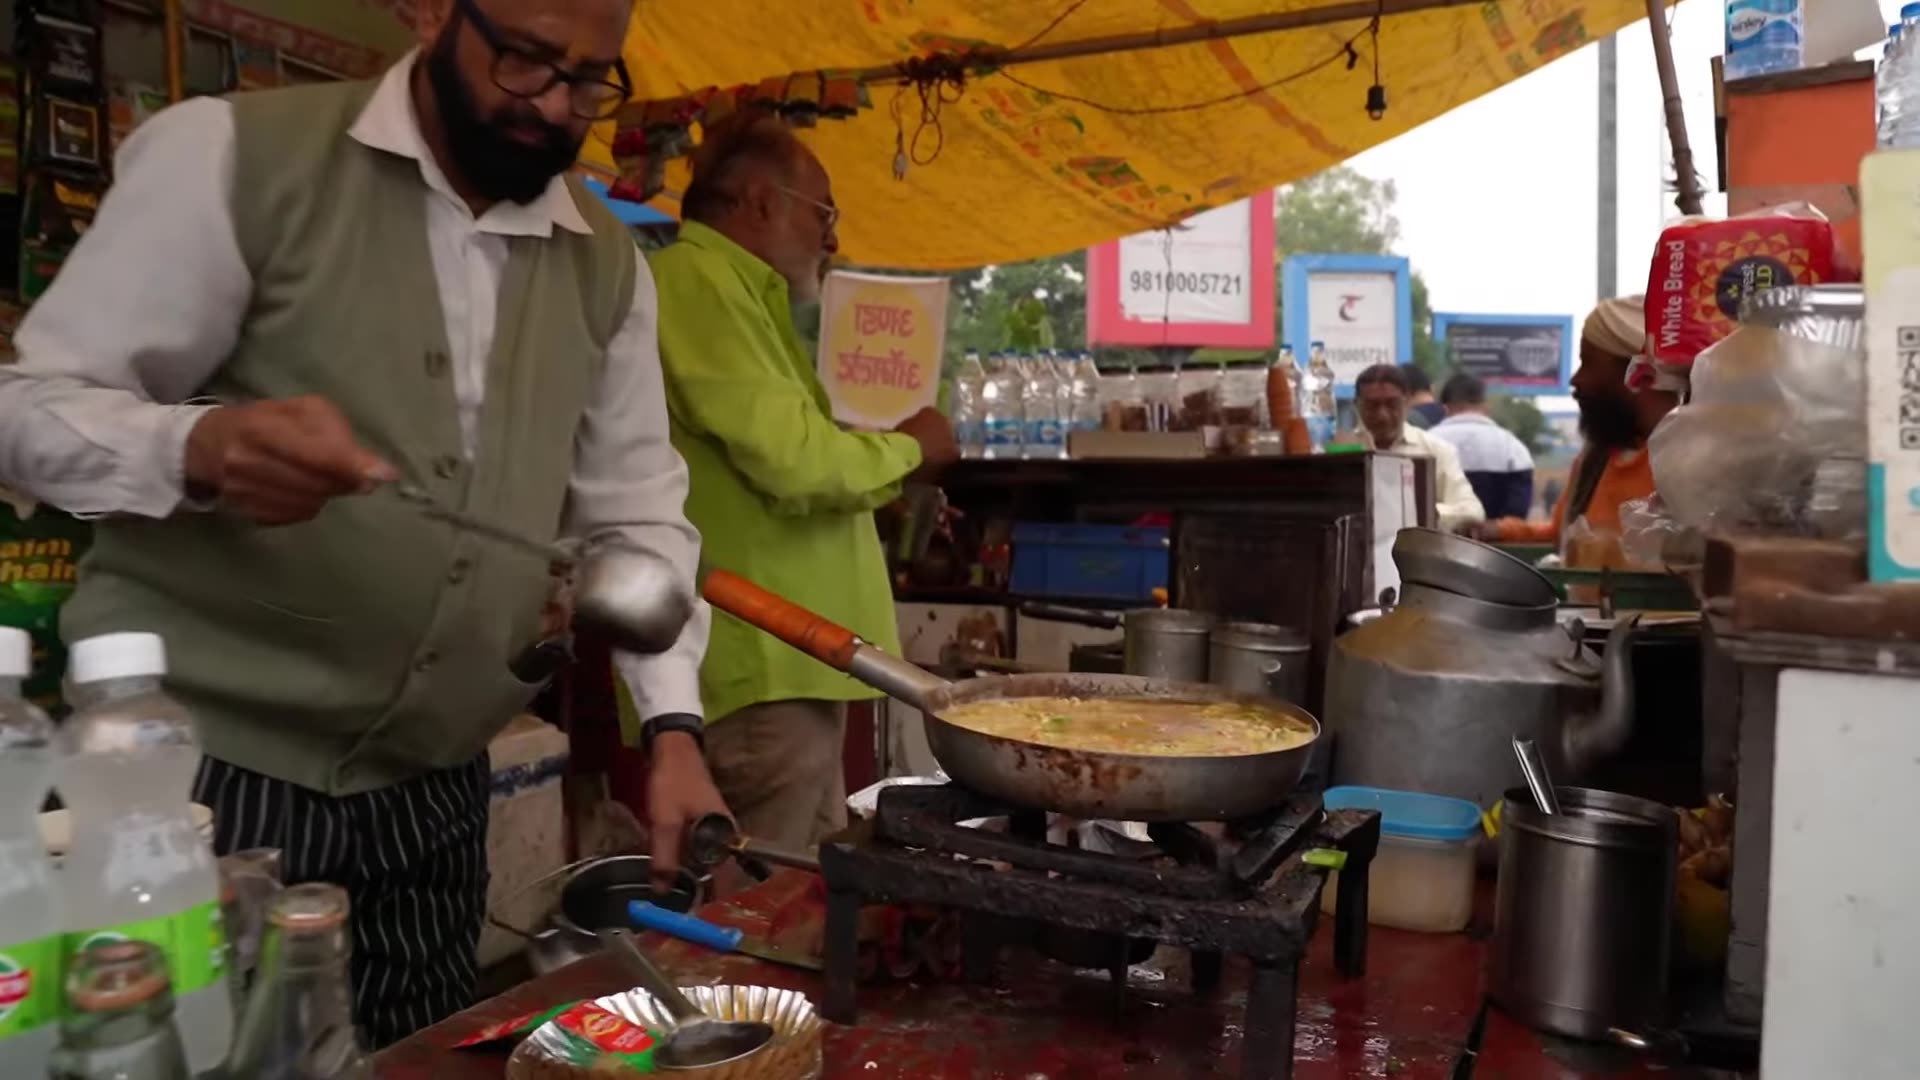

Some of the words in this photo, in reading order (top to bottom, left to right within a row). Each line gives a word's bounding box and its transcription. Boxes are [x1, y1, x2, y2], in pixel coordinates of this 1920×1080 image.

[1129, 269, 1242, 295] 9810005721
[1664, 240, 1686, 291] Bread
[1757, 264, 1774, 290] LD
[1660, 296, 1683, 348] White
